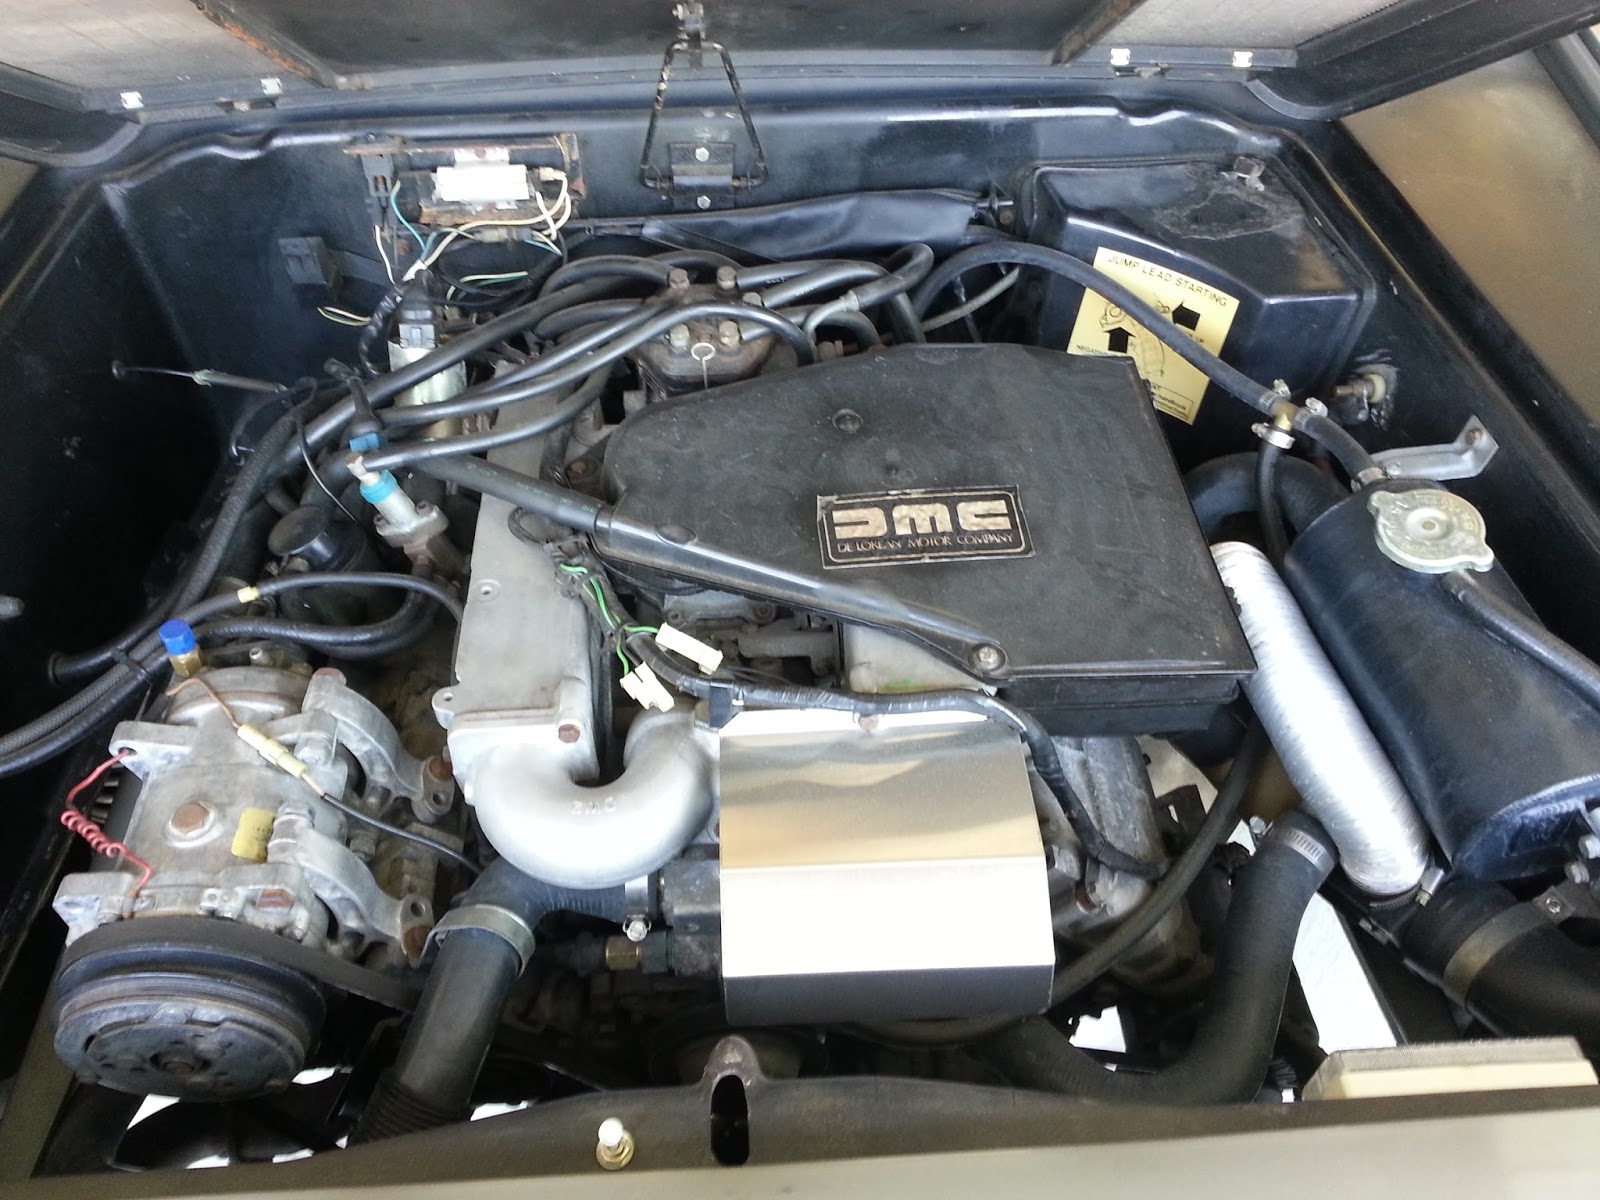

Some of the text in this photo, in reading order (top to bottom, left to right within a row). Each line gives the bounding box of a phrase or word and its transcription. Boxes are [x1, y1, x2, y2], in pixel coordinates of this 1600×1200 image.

[1108, 255, 1228, 307] JUMP LEAD STARTING
[837, 532, 1014, 553] DE LOREAN MOTOR COMPANY
